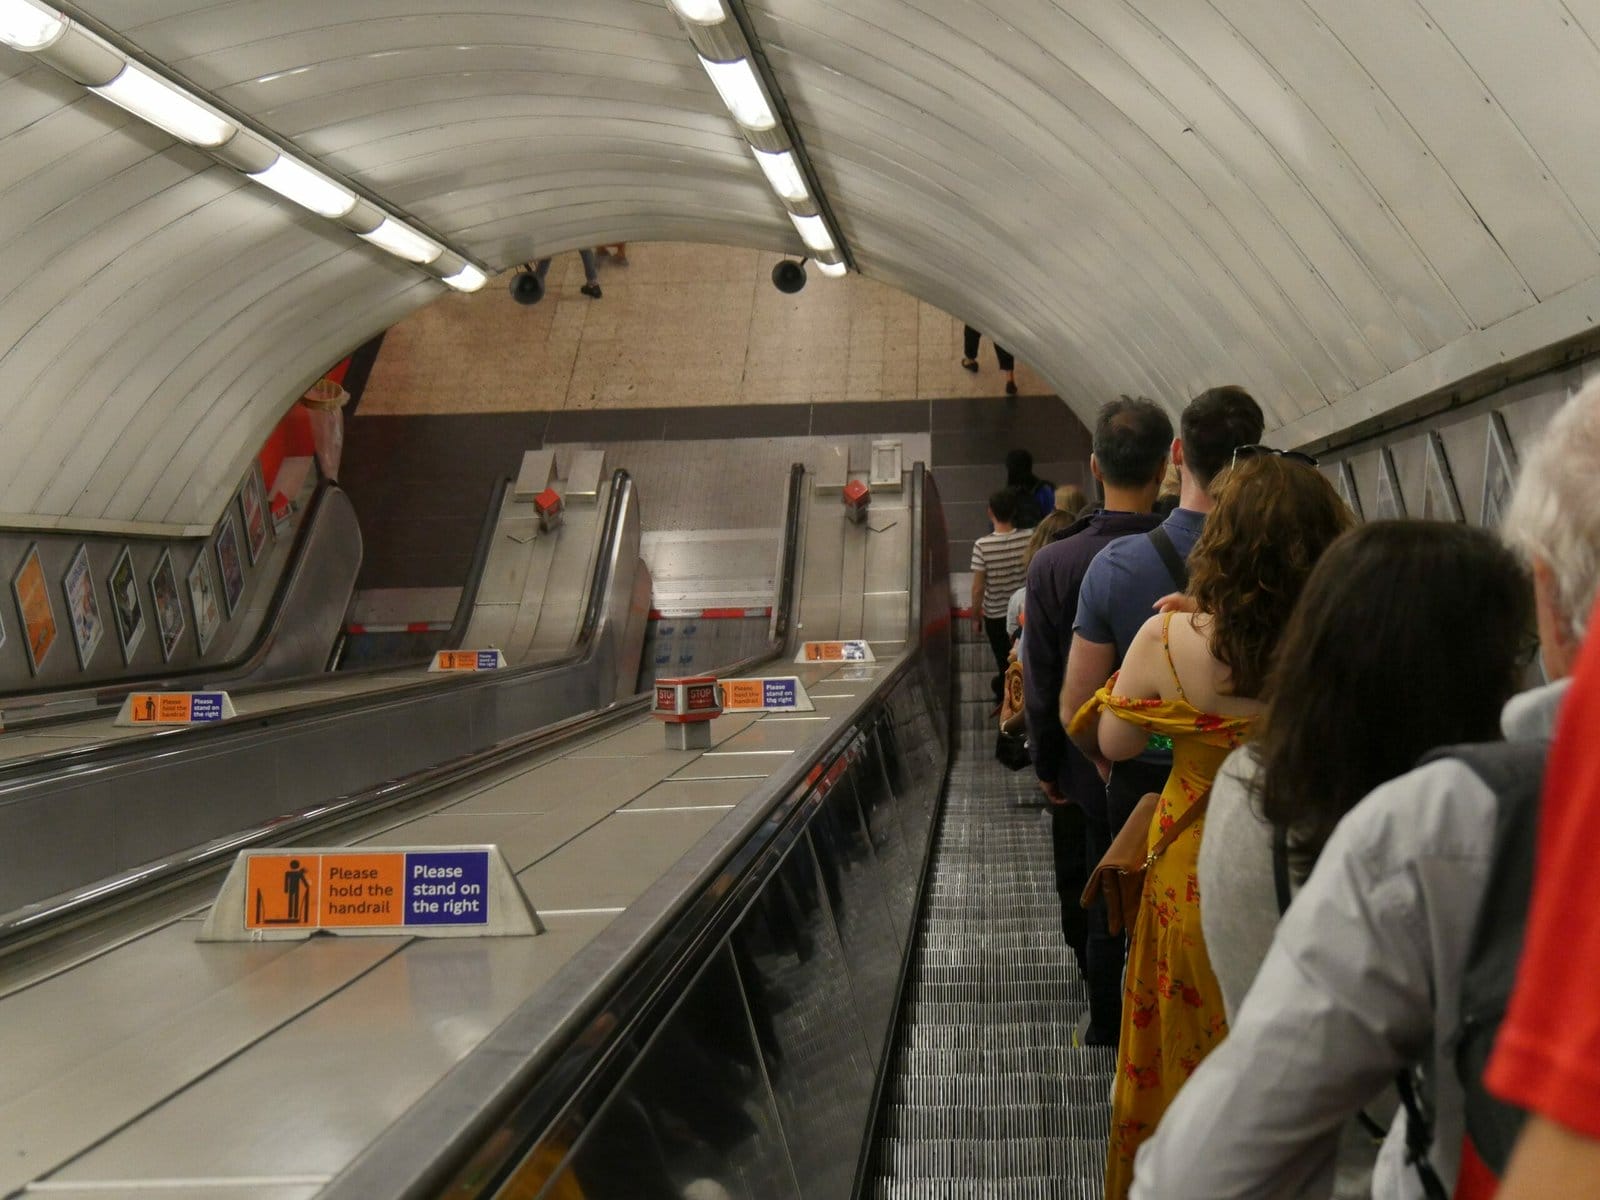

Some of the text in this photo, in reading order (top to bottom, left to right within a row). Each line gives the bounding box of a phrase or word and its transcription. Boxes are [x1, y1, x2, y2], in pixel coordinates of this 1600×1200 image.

[690, 688, 712, 699] STOP
[329, 867, 378, 880] Please
[413, 865, 463, 878] Please
[329, 884, 393, 897] hold the
[412, 881, 480, 896] stand on
[328, 900, 391, 914] handrail
[412, 899, 480, 915] the right
